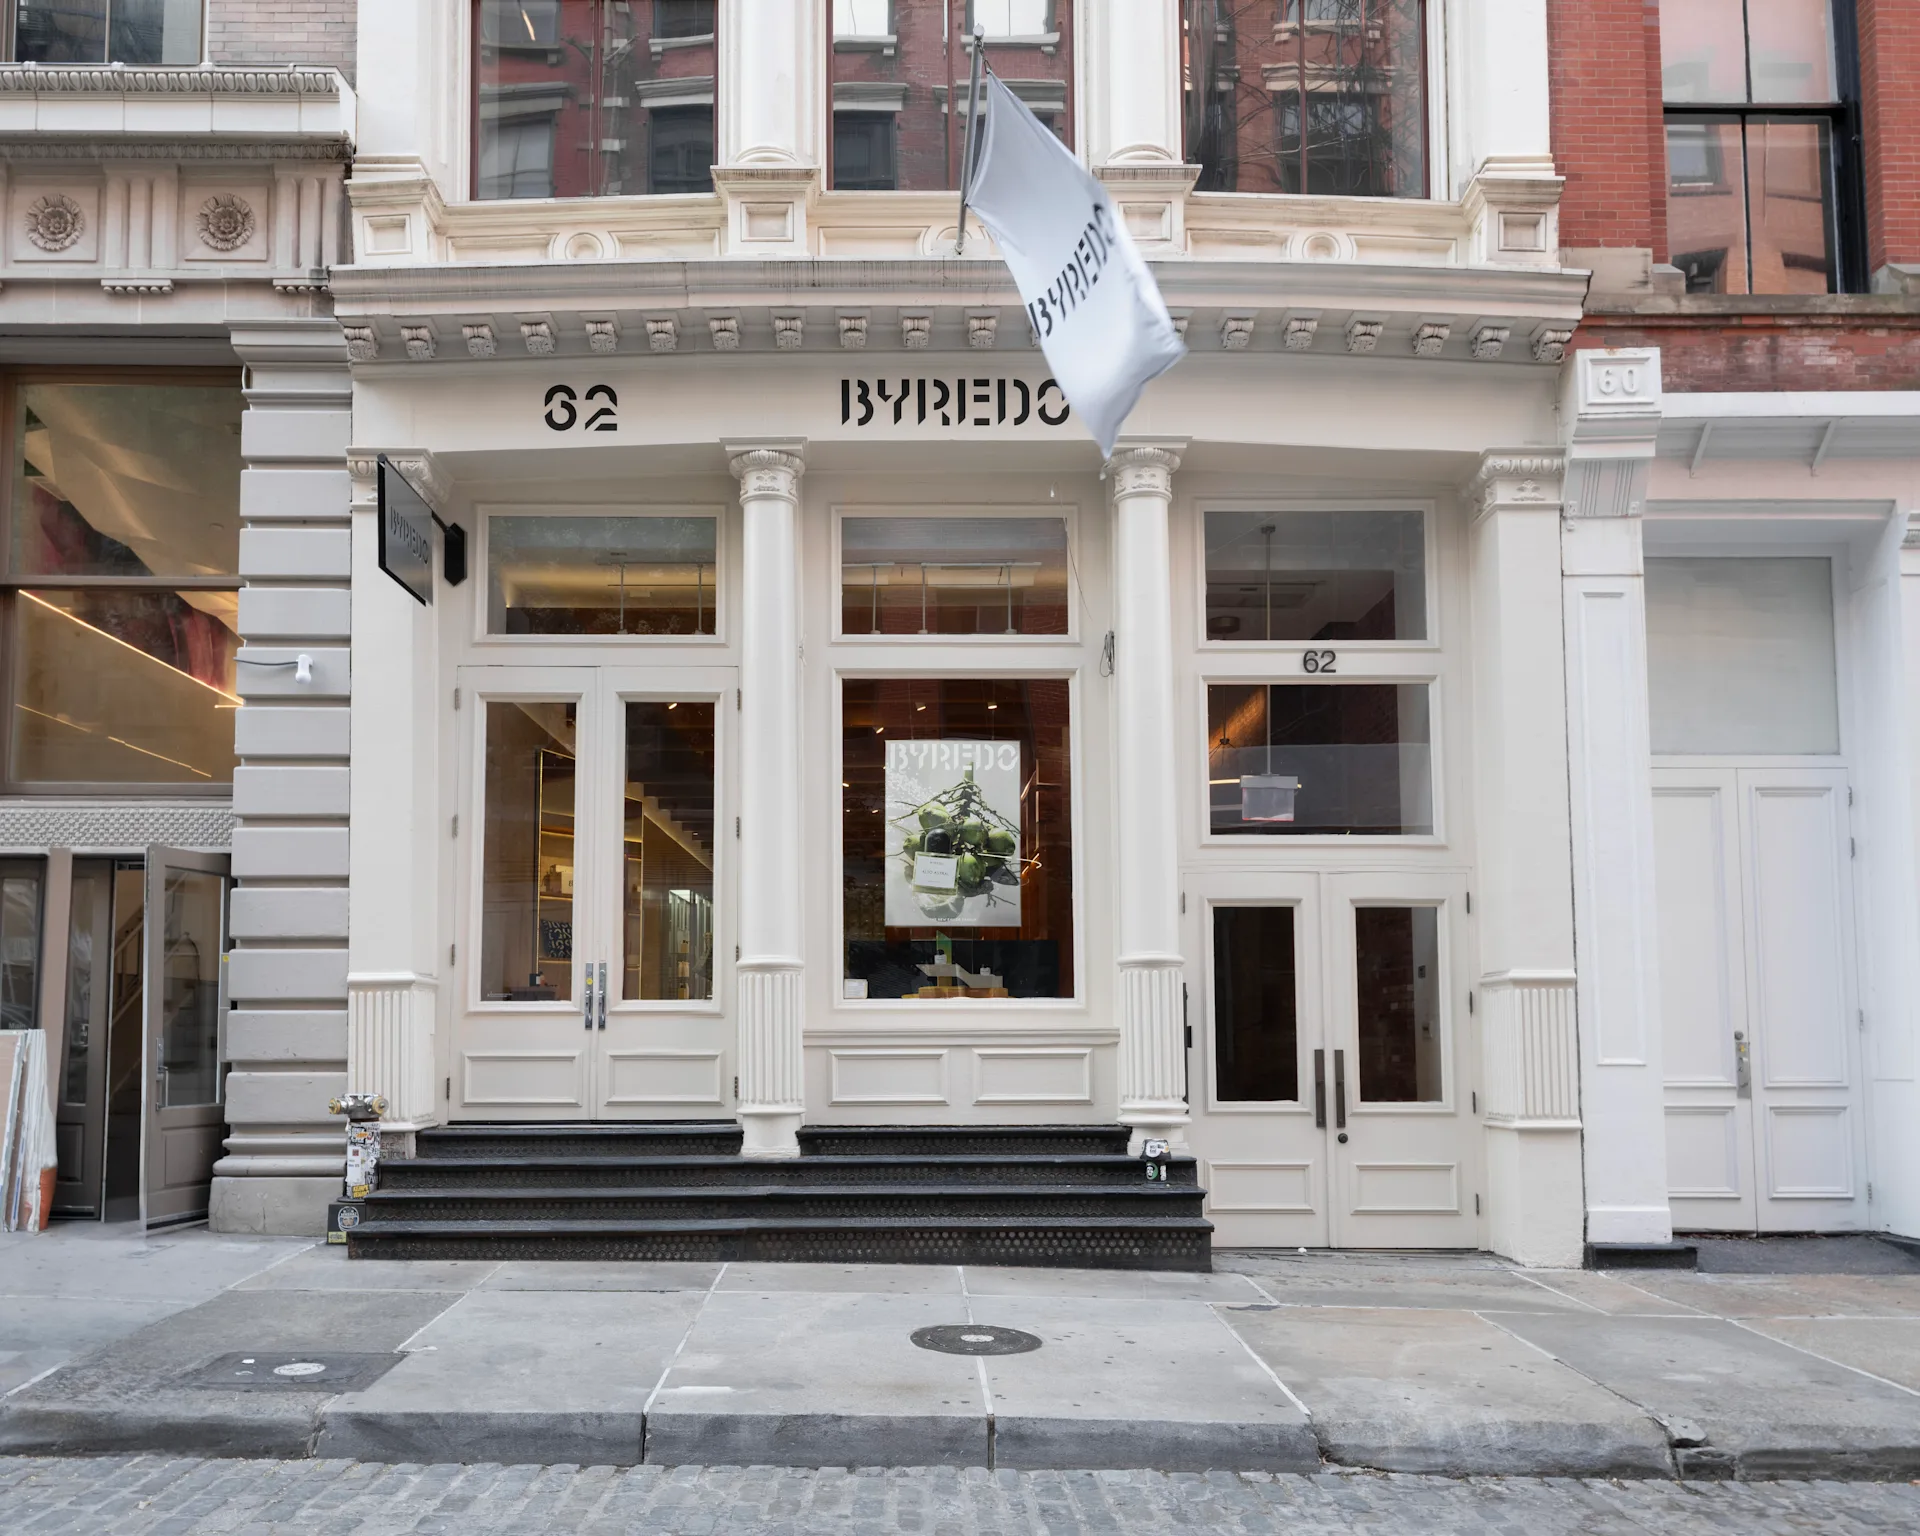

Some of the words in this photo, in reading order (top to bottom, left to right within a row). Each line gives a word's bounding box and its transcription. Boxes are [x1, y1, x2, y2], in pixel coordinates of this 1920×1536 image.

[1028, 202, 1115, 339] BYREDO
[841, 378, 1070, 426] BYREDO
[1598, 367, 1640, 395] 60
[544, 384, 617, 431] 62
[390, 505, 429, 565] BYREDO
[1303, 650, 1337, 673] 62
[889, 743, 1018, 771] BYREDO
